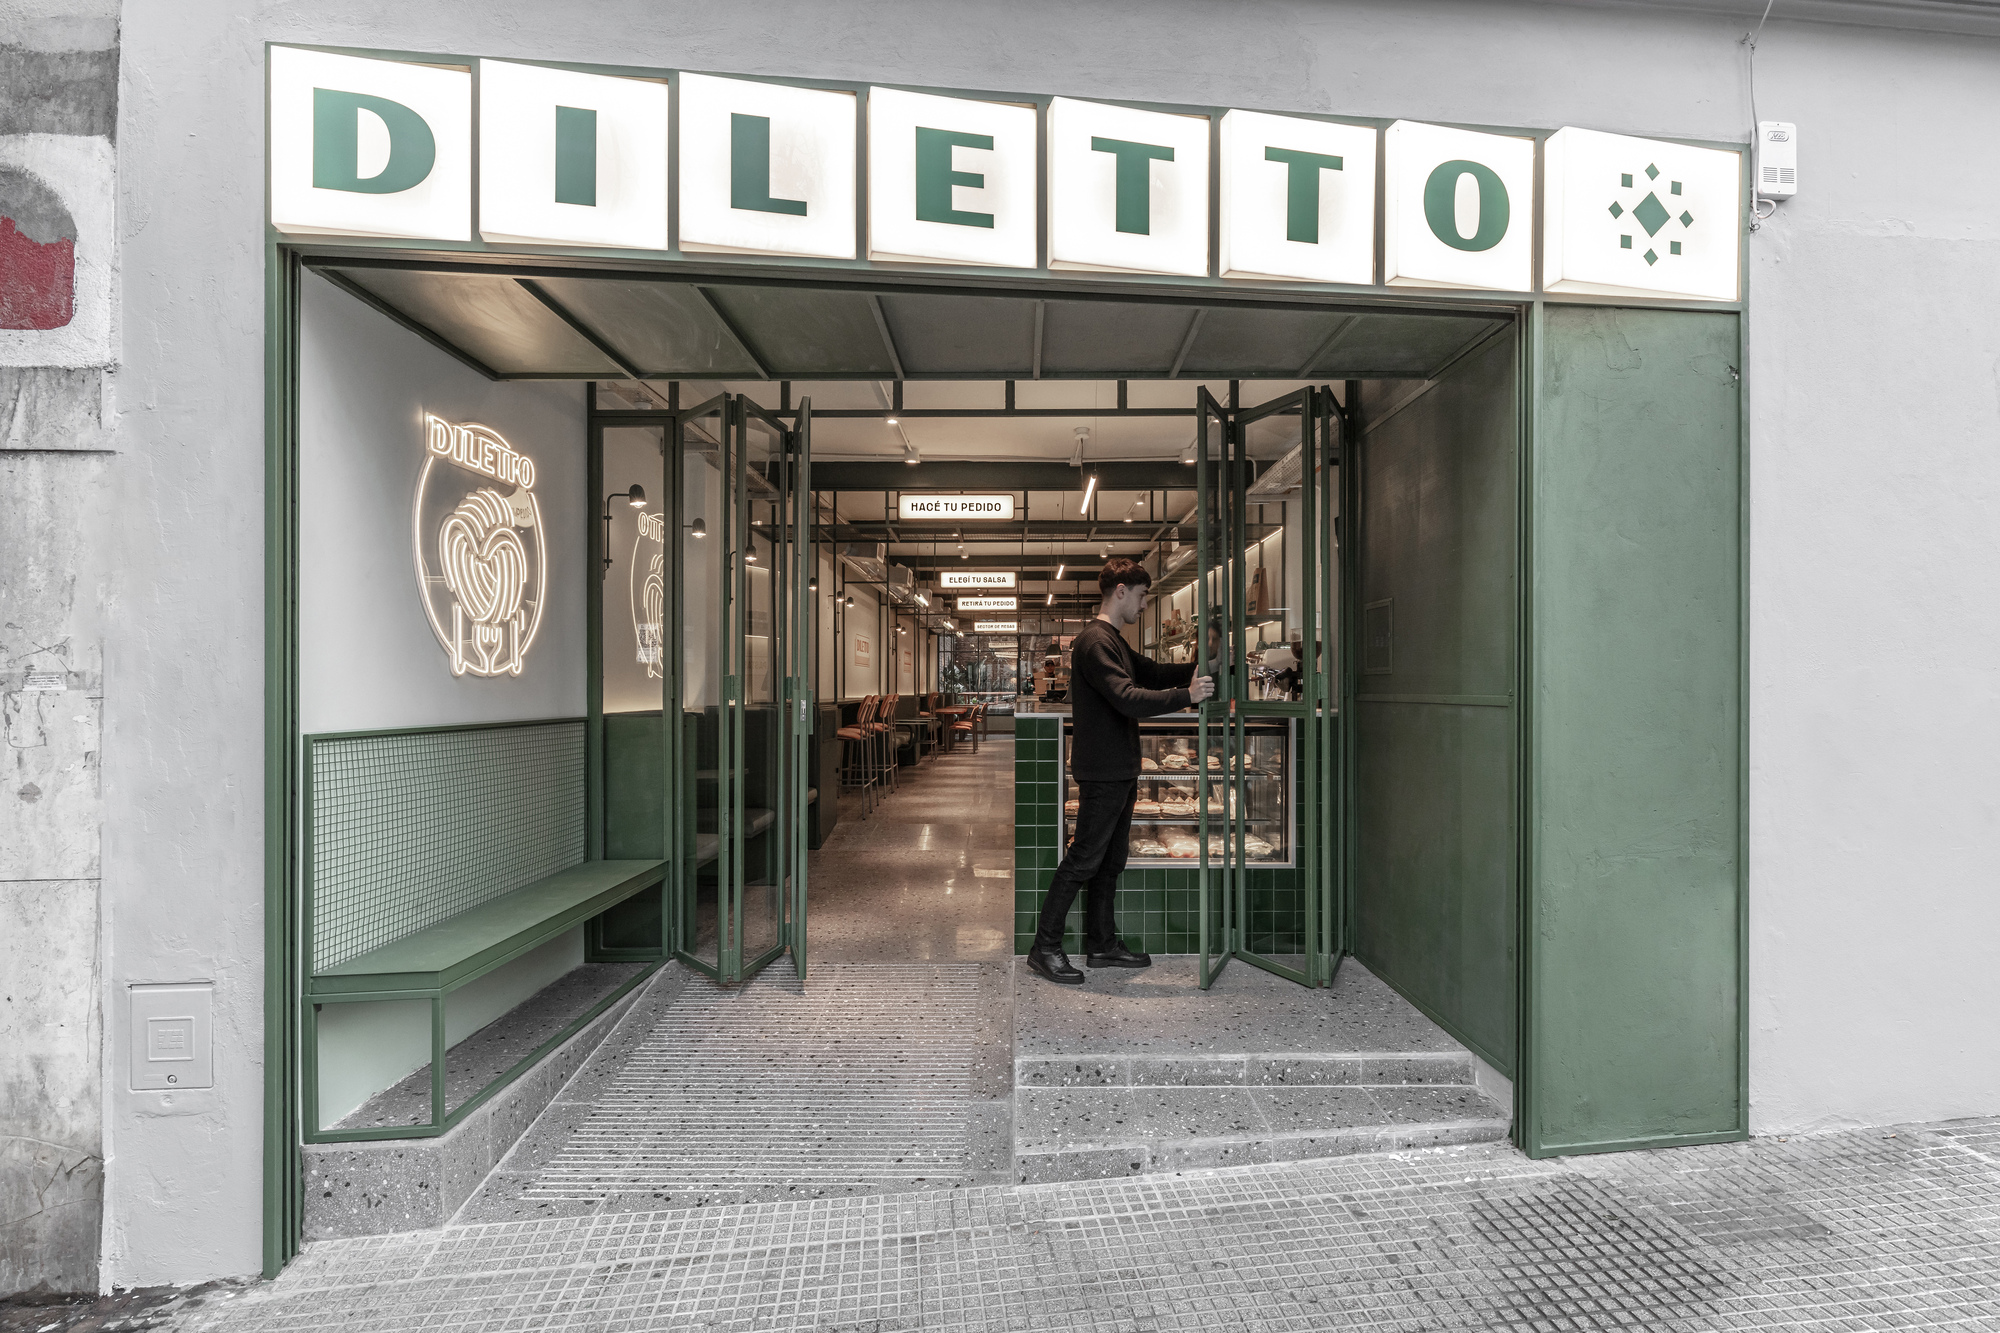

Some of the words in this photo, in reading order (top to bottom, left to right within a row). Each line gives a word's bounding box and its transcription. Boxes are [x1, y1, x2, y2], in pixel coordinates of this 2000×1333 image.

[313, 87, 1510, 252] DILETTO
[427, 414, 535, 489] DILETTO
[911, 501, 940, 512] HACÉ
[944, 502, 958, 512] TU
[961, 502, 1002, 512] PEDIDO
